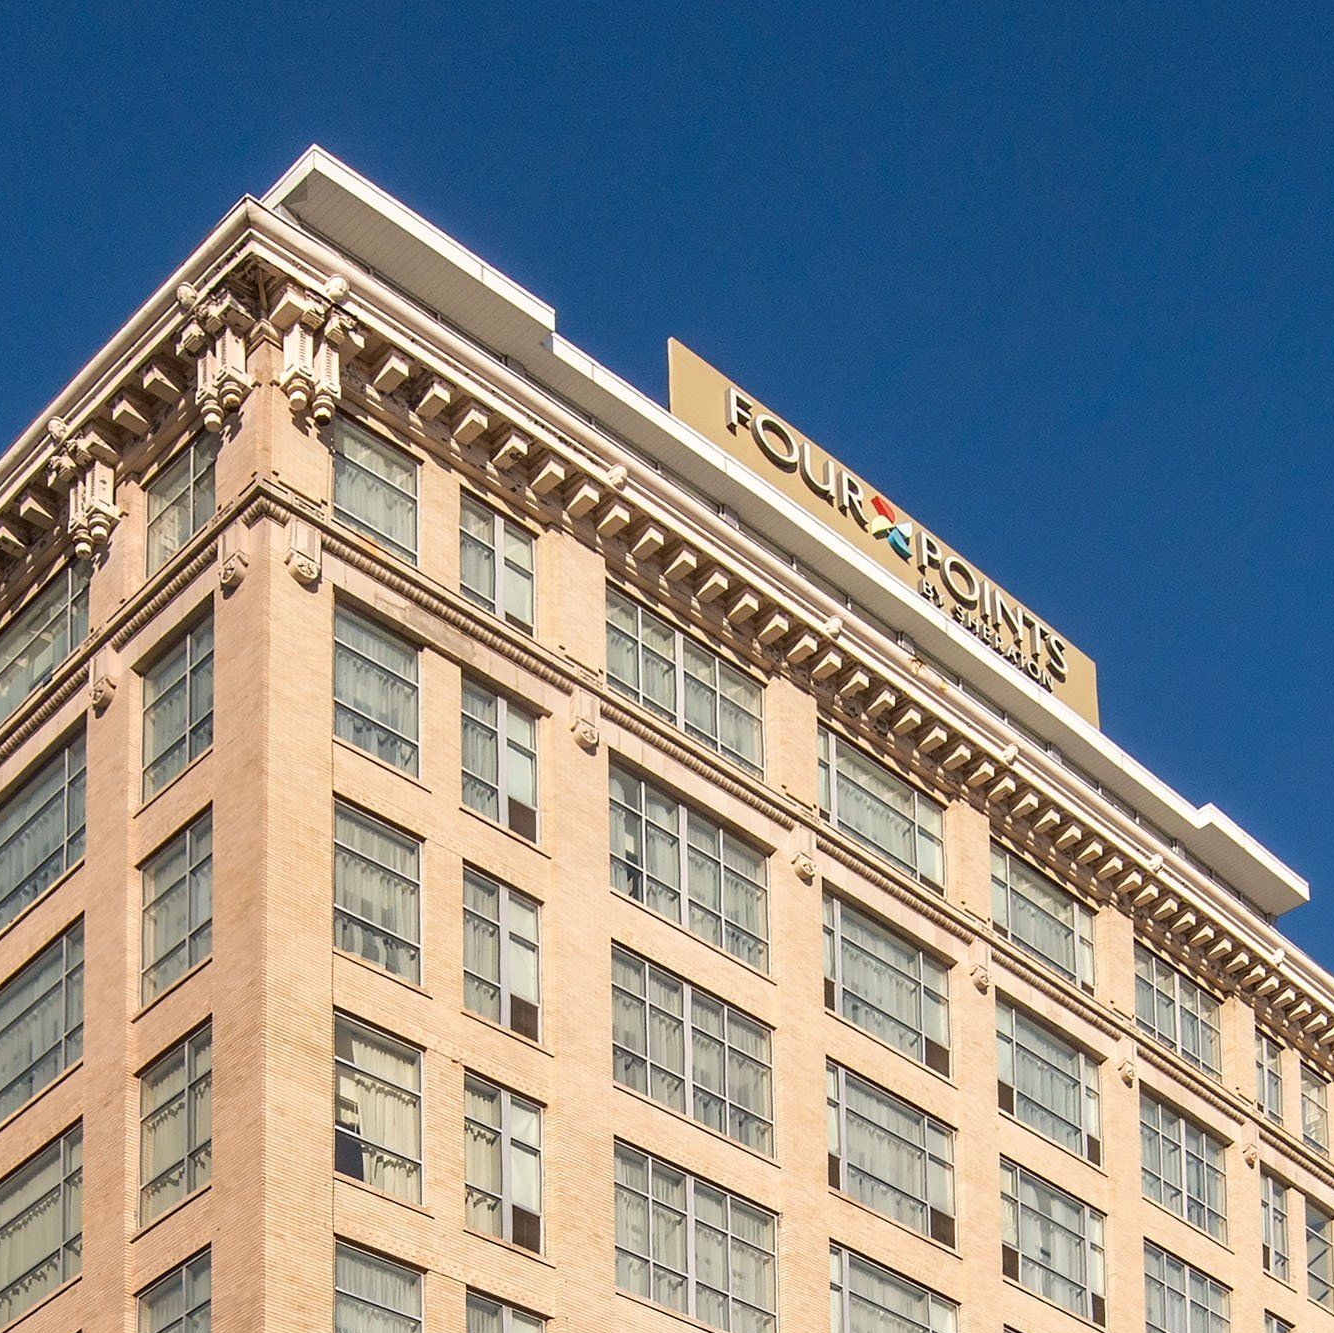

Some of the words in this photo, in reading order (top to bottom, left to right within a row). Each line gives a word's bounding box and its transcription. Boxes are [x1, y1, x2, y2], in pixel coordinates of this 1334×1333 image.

[725, 386, 869, 527] FOUR
[916, 530, 1069, 677] POINTS
[921, 577, 946, 607] BY
[953, 602, 1055, 692] SHERATON
